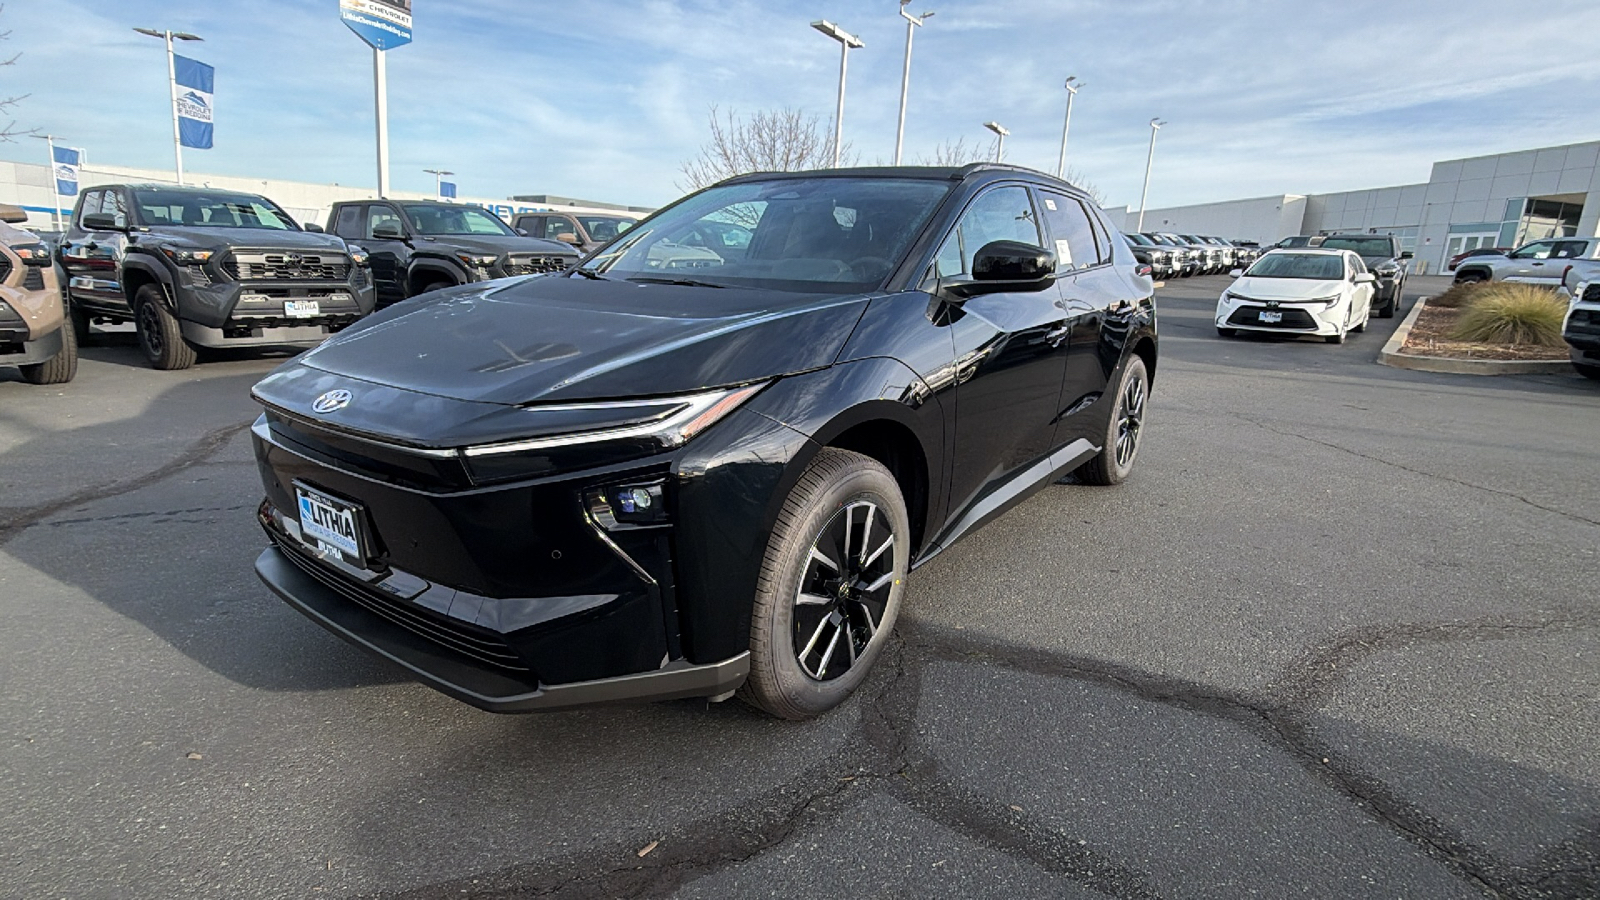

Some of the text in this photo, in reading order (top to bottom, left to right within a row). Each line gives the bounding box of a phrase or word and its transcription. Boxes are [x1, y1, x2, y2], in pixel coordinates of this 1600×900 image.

[369, 4, 409, 23] CHEVROLET
[310, 501, 356, 541] LITHIA
[332, 532, 358, 552] REDDING
